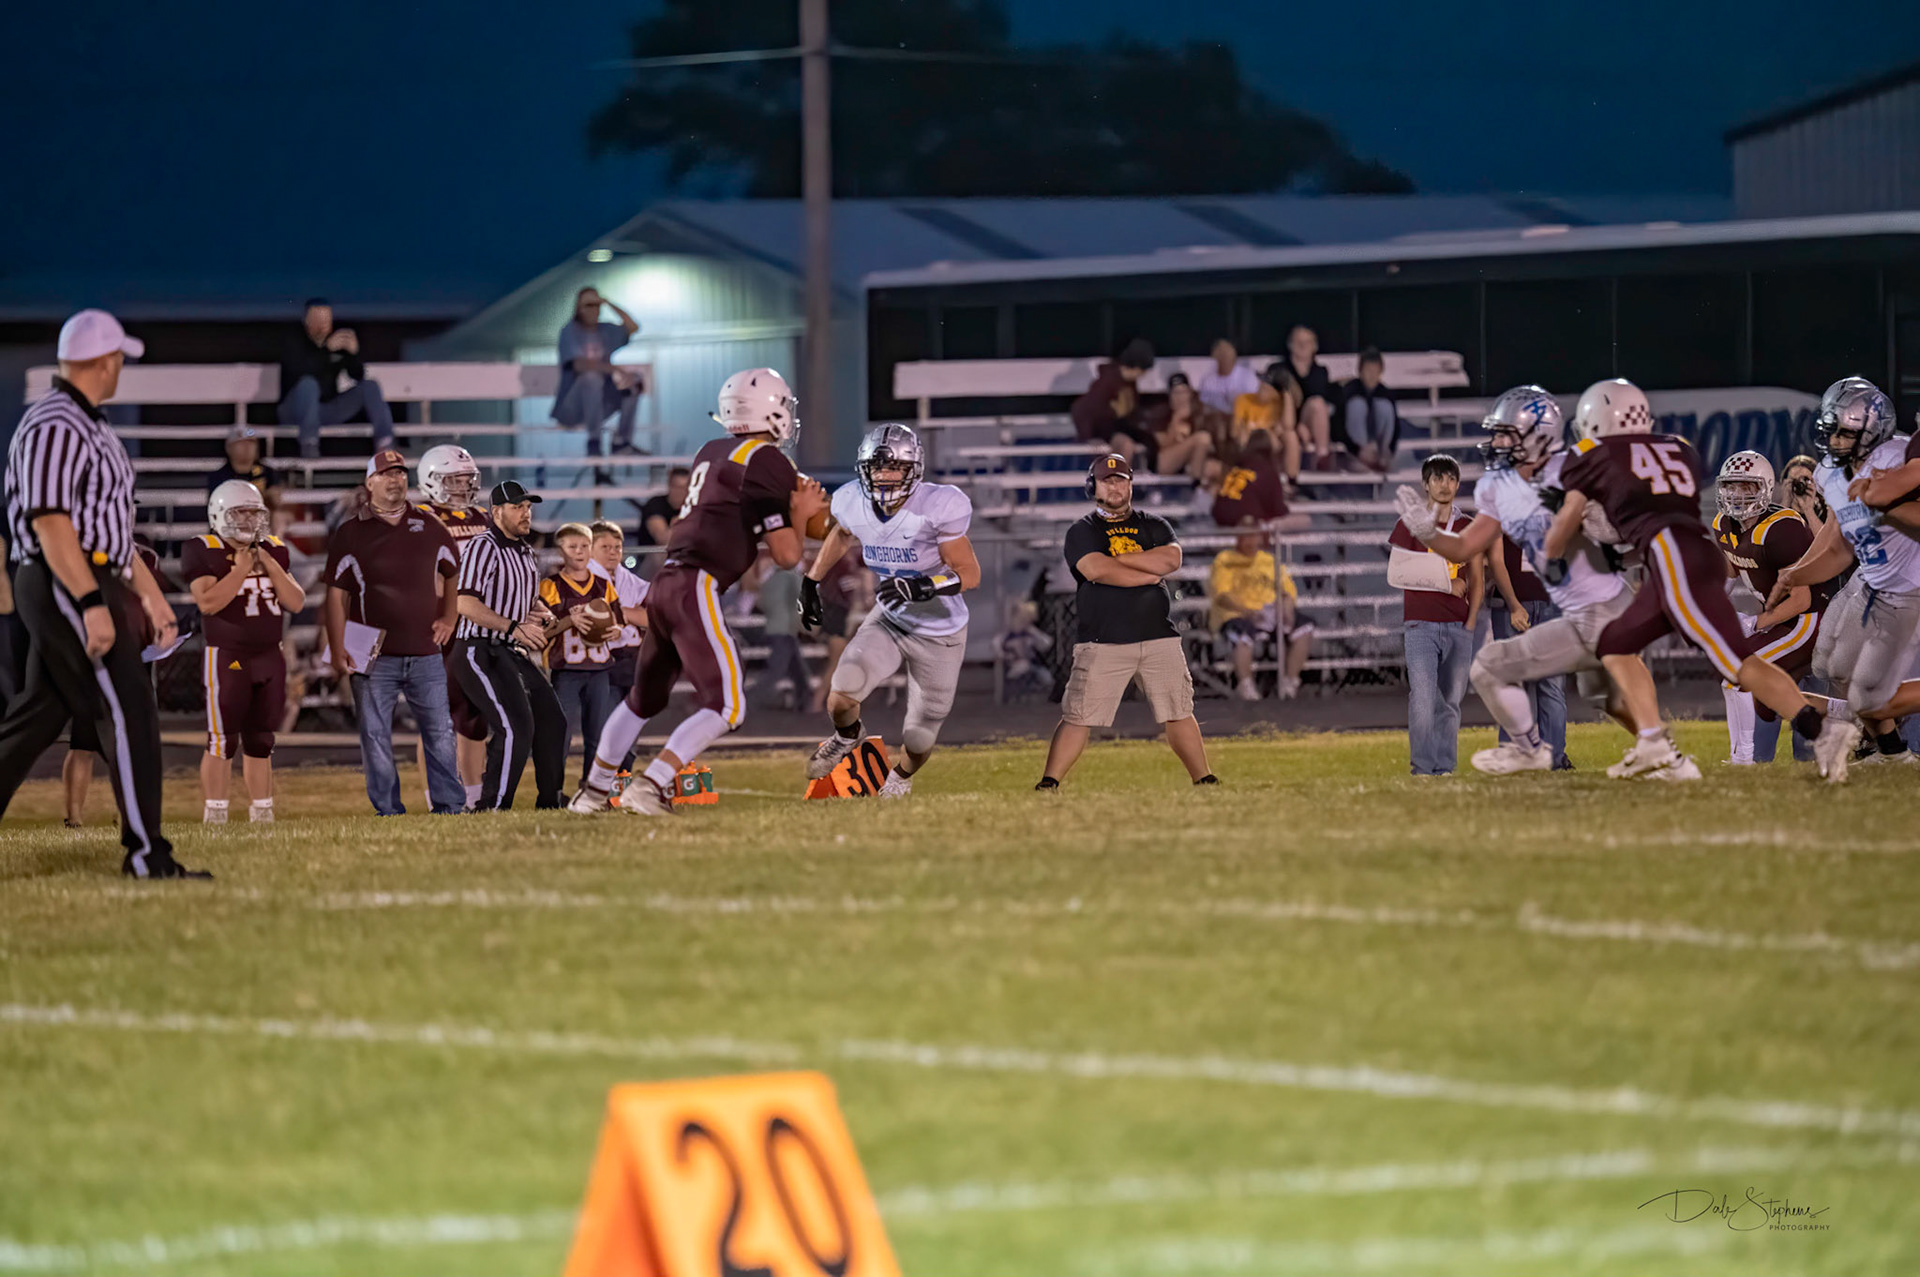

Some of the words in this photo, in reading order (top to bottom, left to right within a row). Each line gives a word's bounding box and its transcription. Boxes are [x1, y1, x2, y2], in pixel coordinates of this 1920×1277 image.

[1630, 443, 1696, 497] 45
[864, 545, 919, 563] ONGHORNS
[684, 779, 694, 790] G
[840, 741, 890, 797] 30
[676, 1117, 850, 1277] 20
